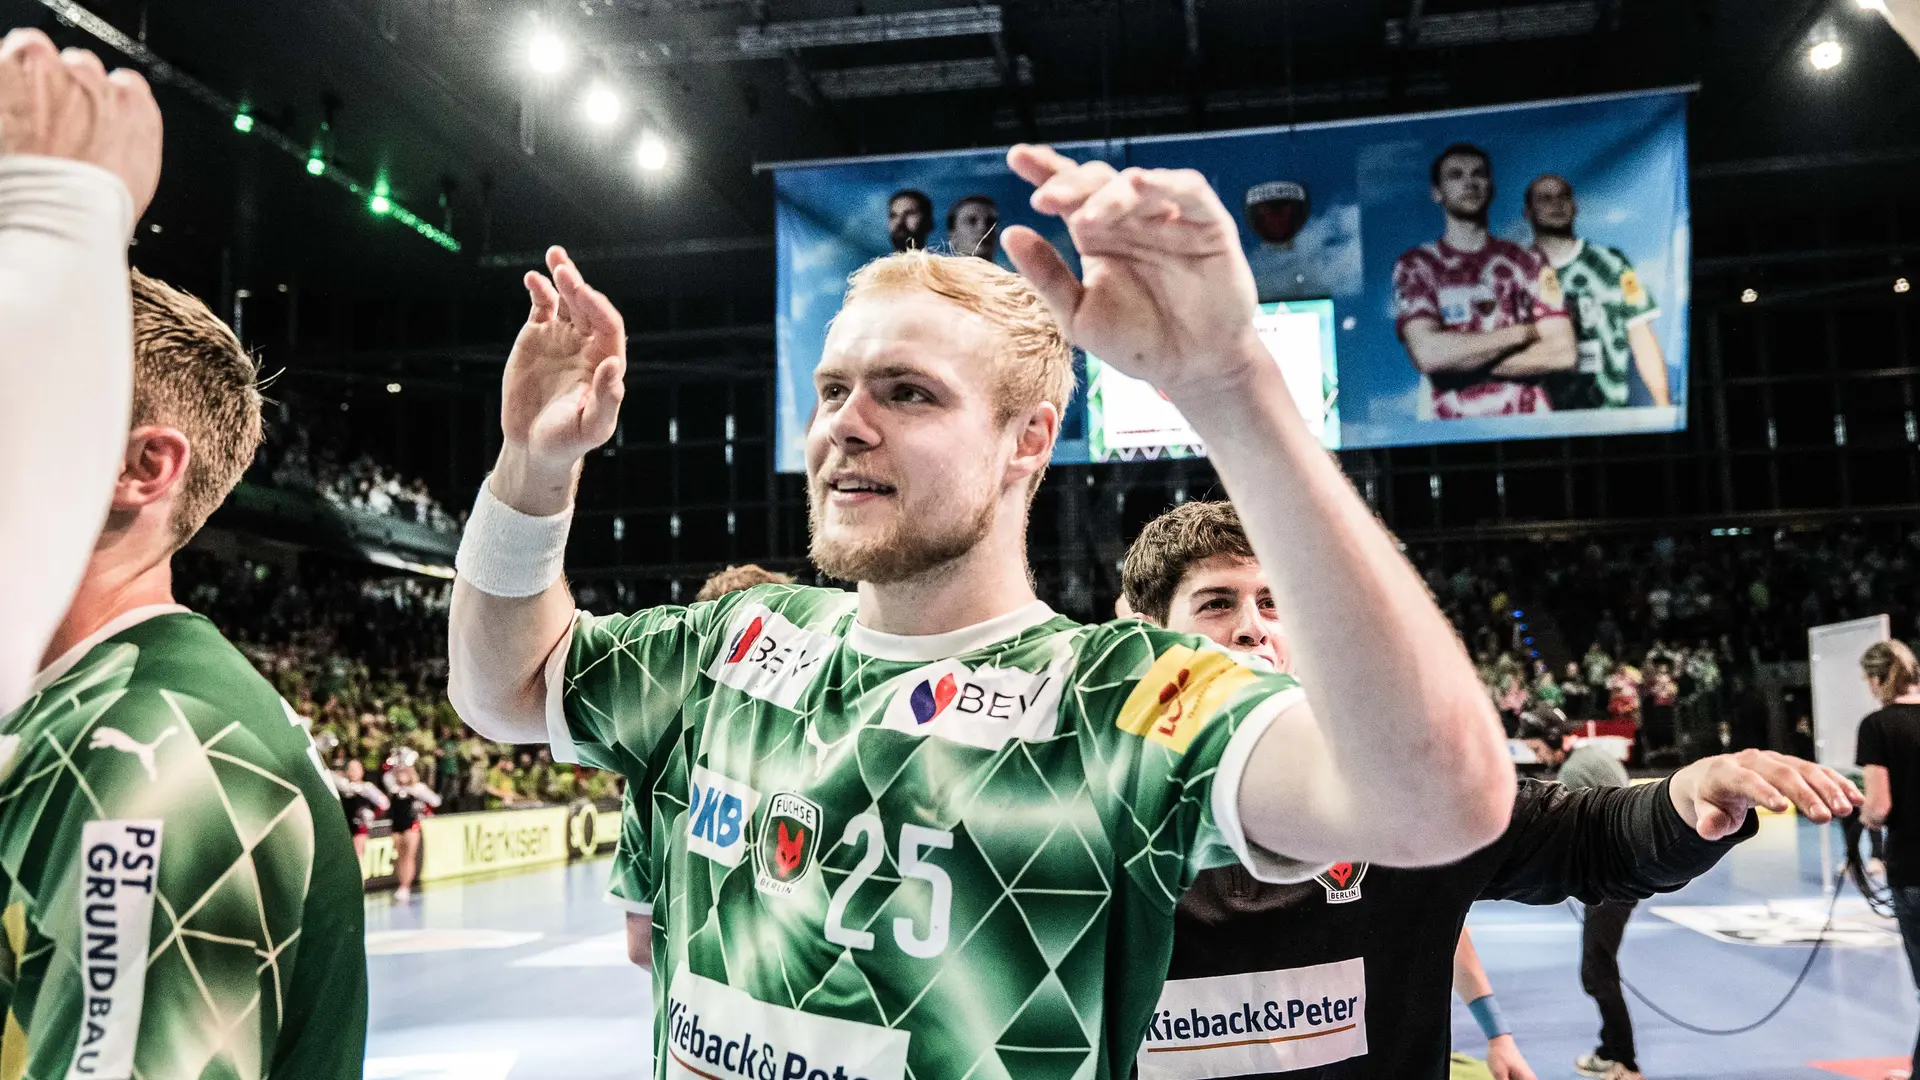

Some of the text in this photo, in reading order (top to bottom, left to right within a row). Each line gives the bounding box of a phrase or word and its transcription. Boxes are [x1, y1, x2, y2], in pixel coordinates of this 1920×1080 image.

[775, 797, 813, 824] FÜCHSE
[121, 826, 156, 895] PST
[463, 821, 550, 866] Markisen
[759, 877, 793, 895] BERLIN
[824, 812, 954, 959] 25
[1330, 889, 1357, 900] BERLIN
[75, 843, 118, 1075] GRUNDBAU
[668, 997, 871, 1080] Kieback&P
[1145, 995, 1358, 1042] Kieback&Peter
